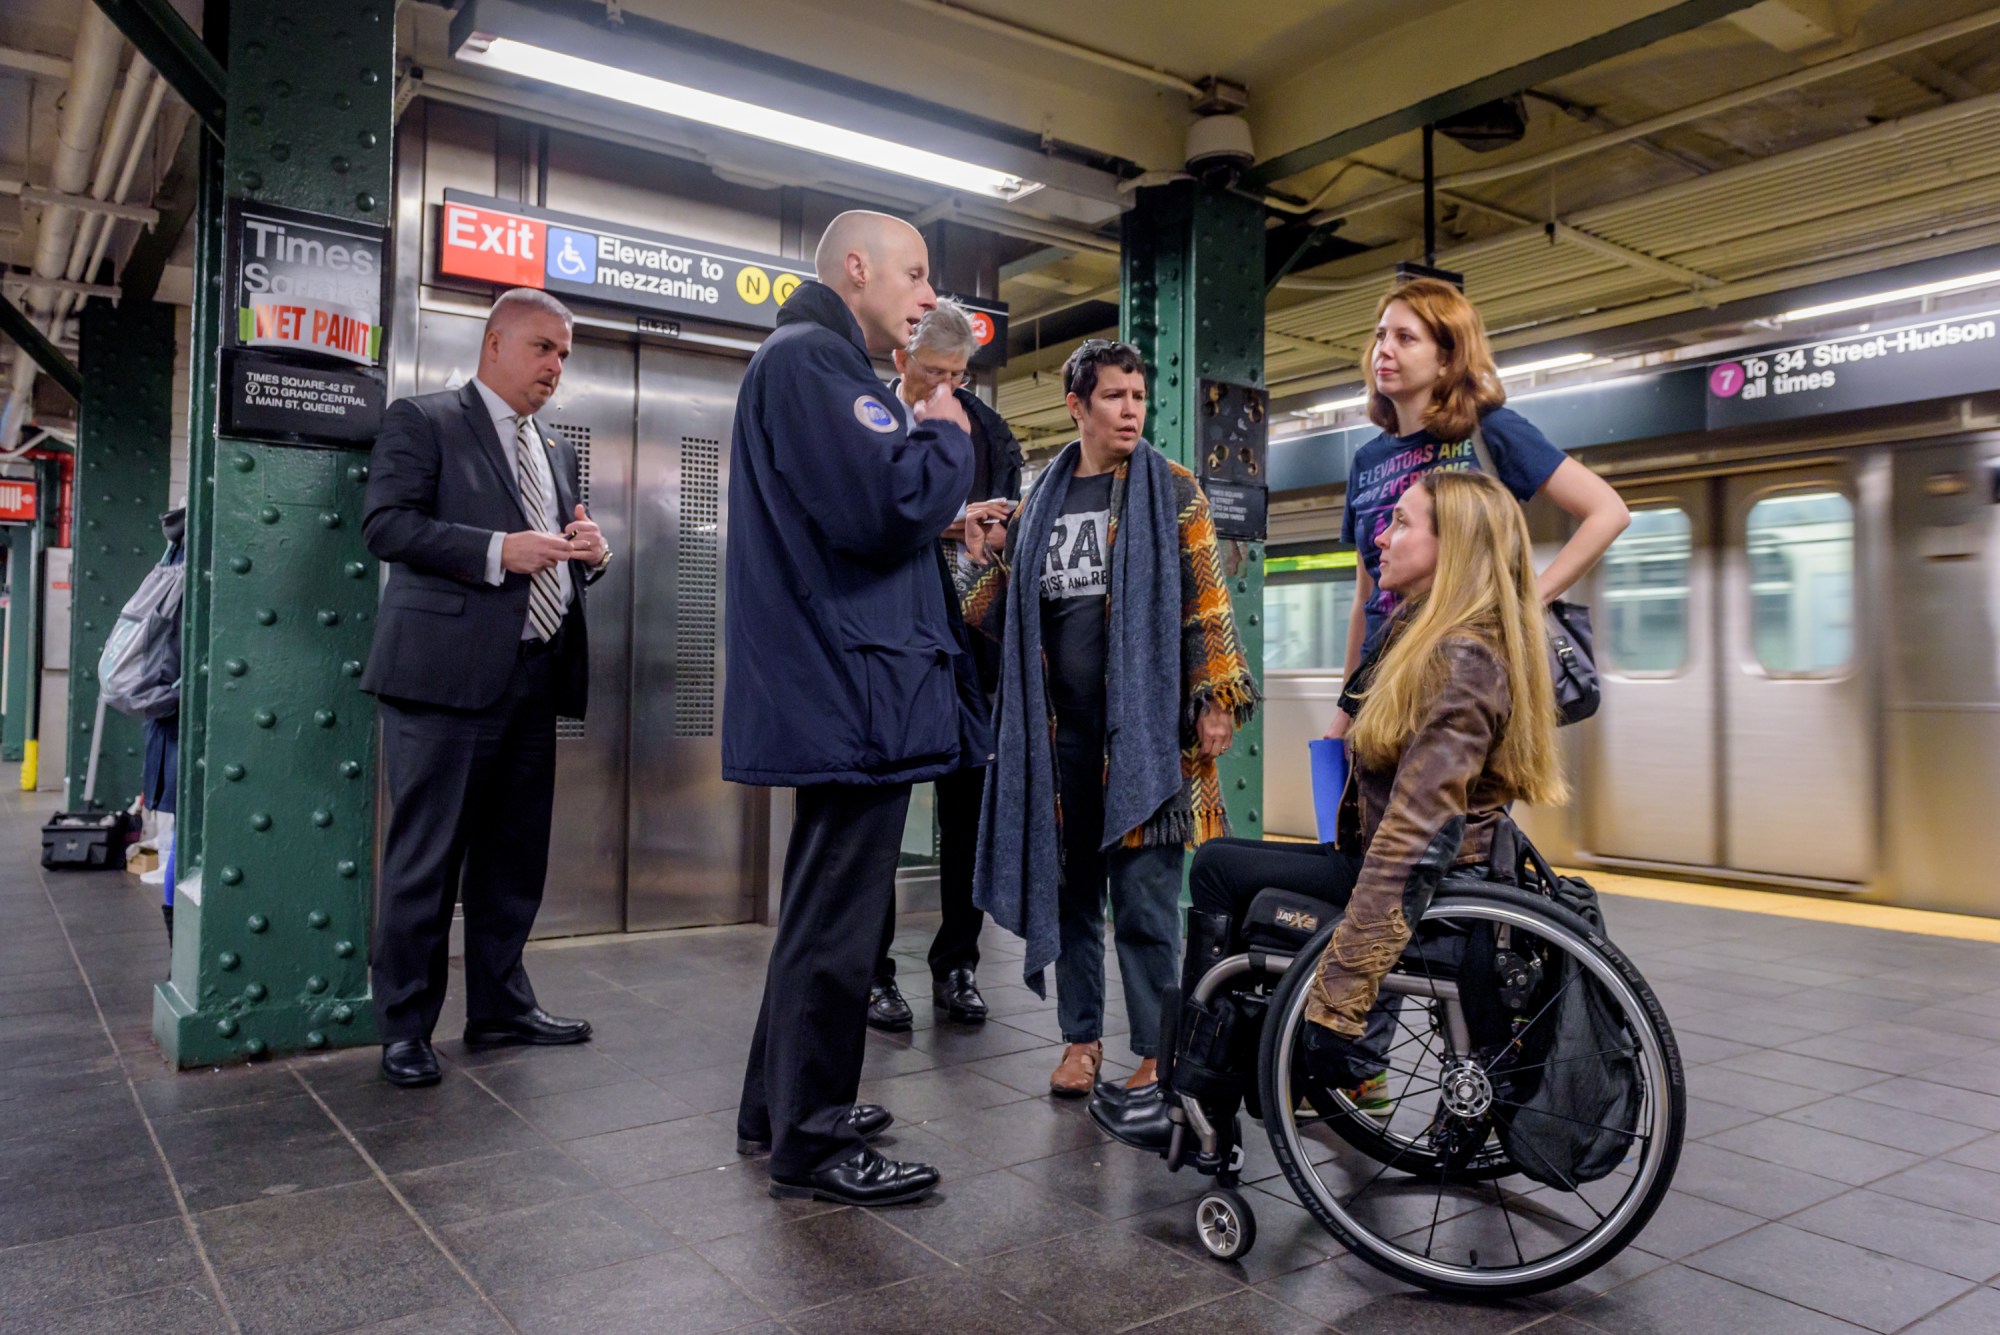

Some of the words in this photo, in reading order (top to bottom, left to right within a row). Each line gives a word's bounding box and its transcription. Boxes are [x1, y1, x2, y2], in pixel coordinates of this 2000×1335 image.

[246, 220, 373, 275] Times
[448, 207, 534, 260] Exit
[598, 236, 692, 274] Elevator
[700, 257, 724, 281] to
[597, 266, 719, 304] mezzanine
[746, 275, 761, 295] N
[256, 303, 306, 341] WET
[312, 309, 369, 357] PAINT
[638, 319, 679, 336] EL232
[1743, 358, 1768, 379] To
[1774, 349, 1806, 373] 34
[1813, 320, 1995, 368] Street-Hudson
[246, 371, 279, 385] TIMES
[281, 376, 340, 393] SQUARE-42
[341, 384, 356, 394] ST
[264, 385, 279, 396] TO
[280, 388, 318, 401] GRAND
[320, 393, 367, 407] CENTRAL
[1719, 370, 1735, 391] 7
[1742, 380, 1767, 400] all
[1773, 370, 1836, 395] times
[245, 396, 253, 405] &
[255, 396, 282, 408] MAIN
[285, 400, 300, 410] ST,
[302, 401, 346, 415] QUEENS
[1359, 443, 1434, 489] ELEVATORS
[1438, 438, 1473, 460] ARE
[1040, 574, 1065, 595] RISE
[1068, 576, 1089, 589] AND
[1600, 944, 1639, 983] PLUS
